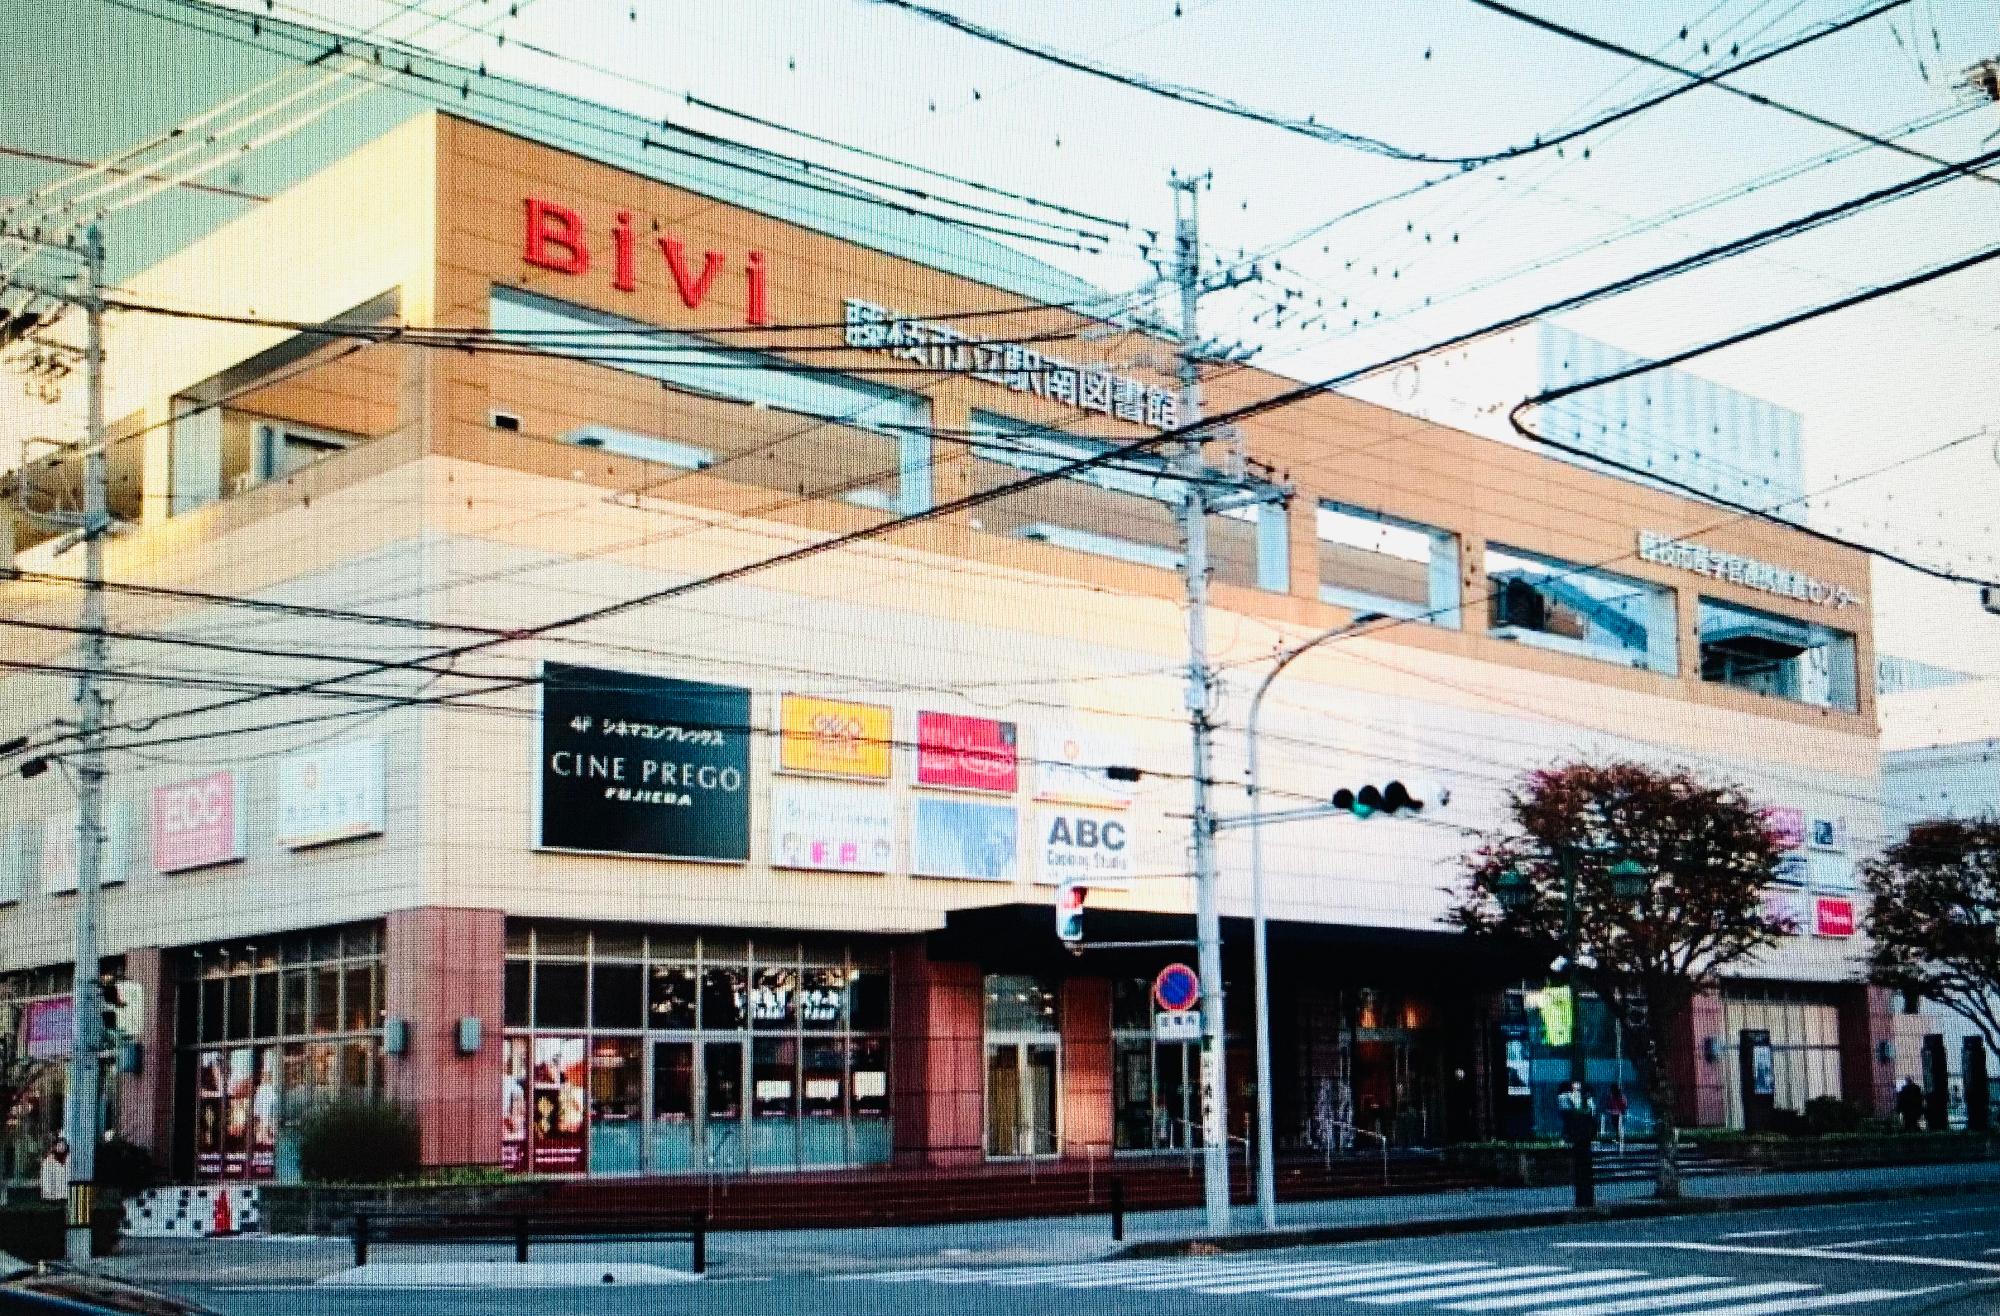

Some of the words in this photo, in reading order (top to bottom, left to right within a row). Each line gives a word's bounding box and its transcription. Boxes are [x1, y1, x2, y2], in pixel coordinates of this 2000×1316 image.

[551, 750, 626, 782] CINE
[642, 759, 742, 793] PREGO
[1047, 815, 1127, 852] ABC
